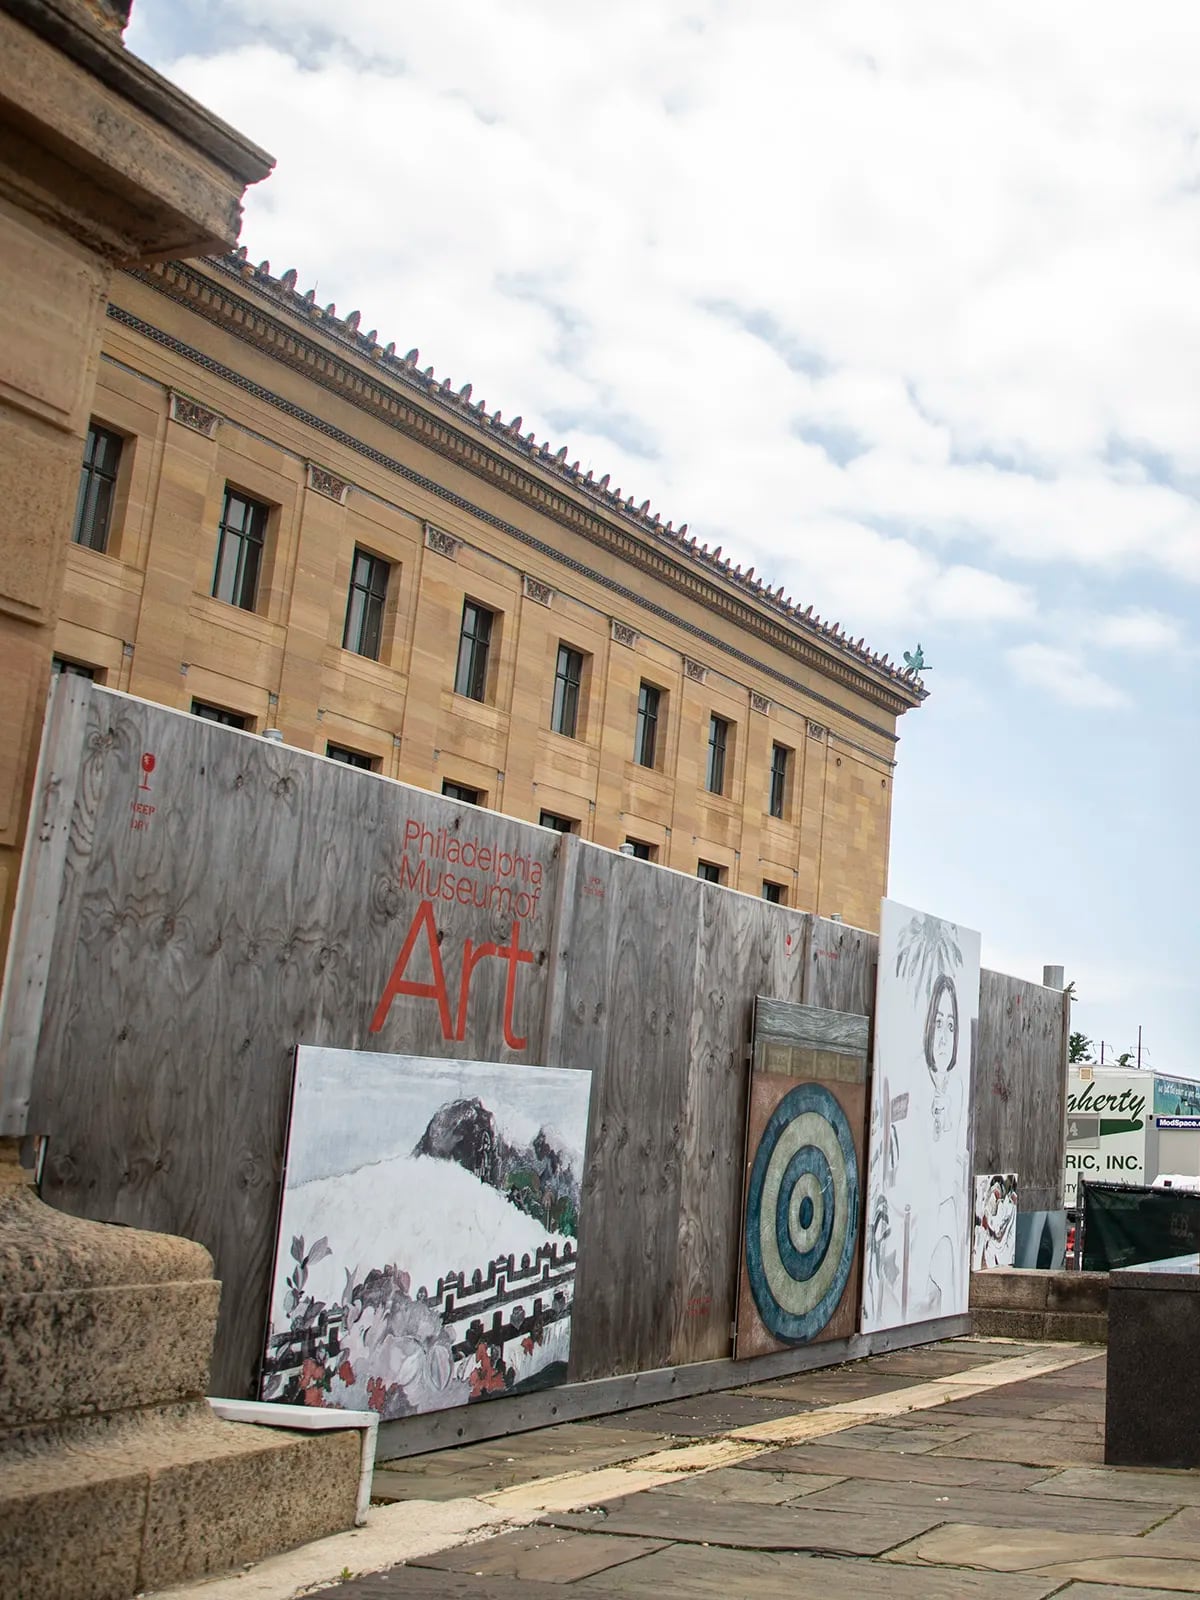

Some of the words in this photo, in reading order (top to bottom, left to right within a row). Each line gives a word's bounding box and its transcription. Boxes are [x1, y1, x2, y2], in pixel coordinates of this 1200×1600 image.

[403, 819, 543, 886] Philadelphia
[399, 855, 512, 912] Museum
[514, 887, 542, 919] of
[369, 900, 534, 1050] Art
[1064, 1183, 1077, 1193] TY
[1065, 1155, 1100, 1172] RIC,
[1106, 1155, 1143, 1170] INC.
